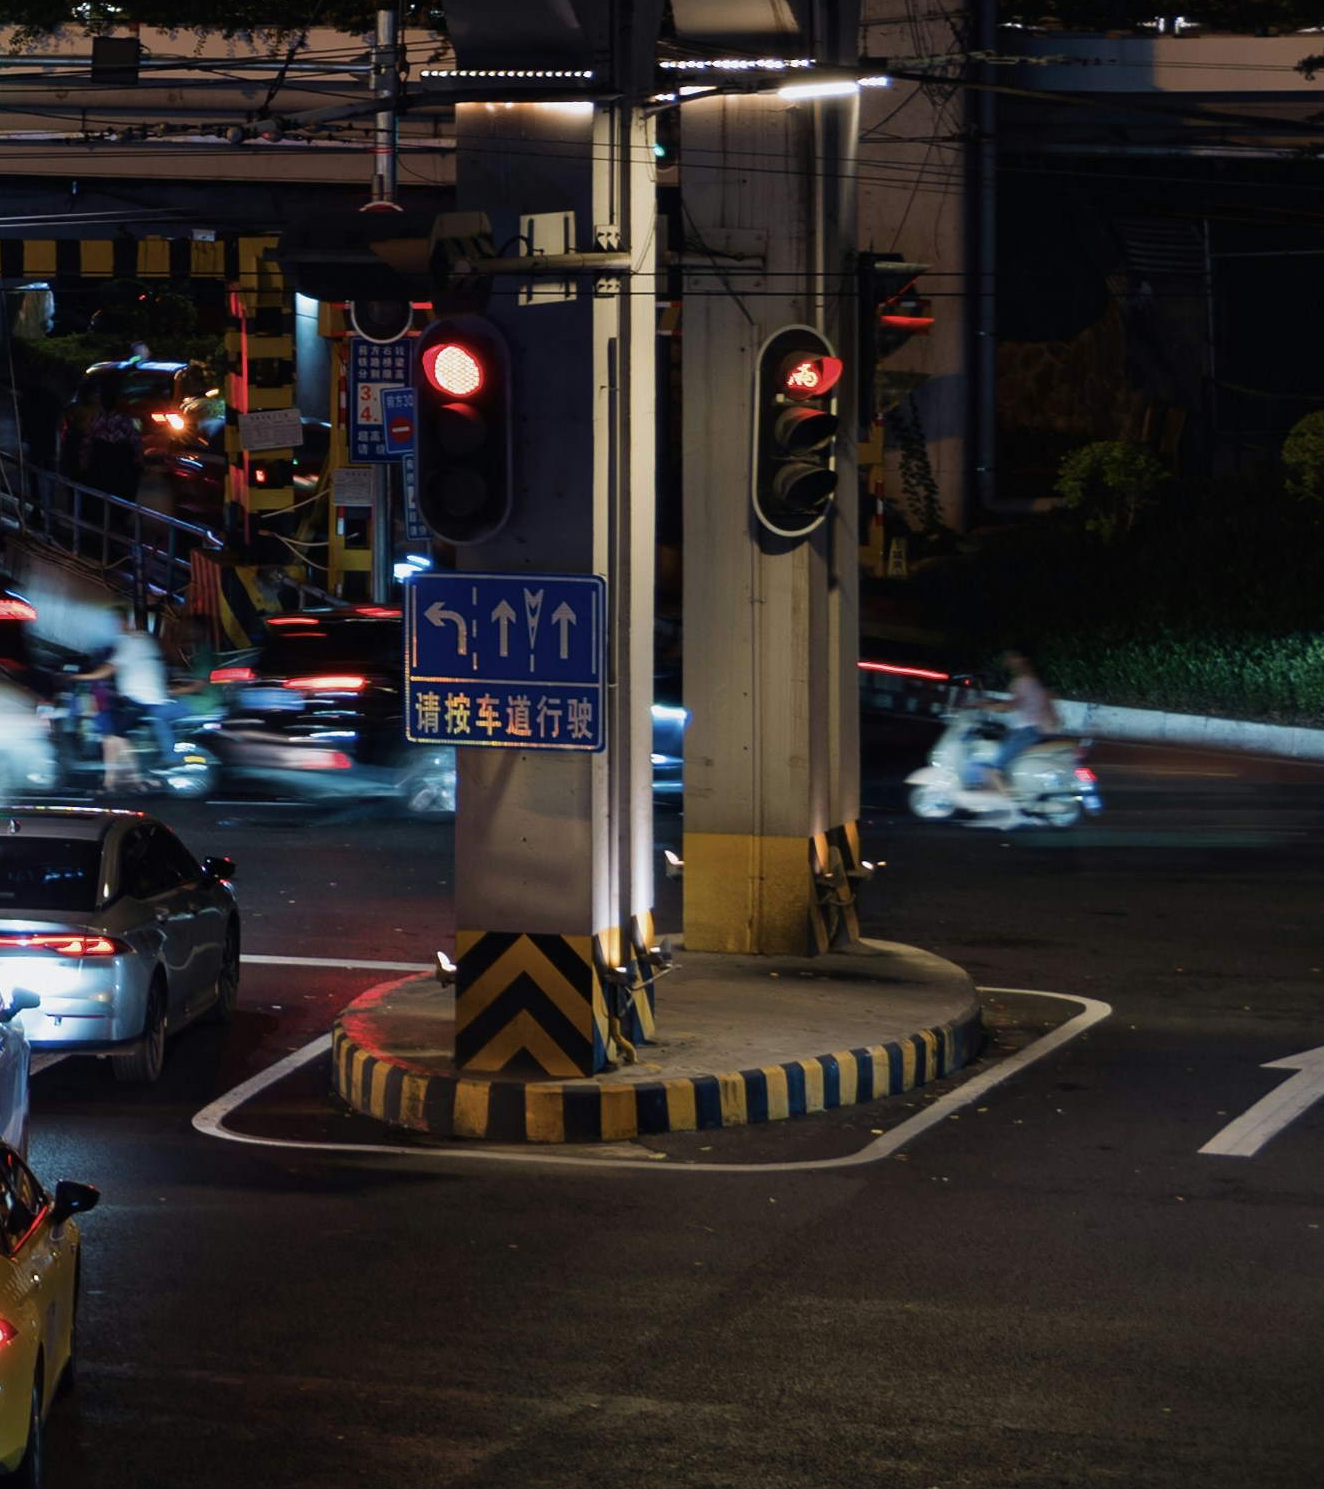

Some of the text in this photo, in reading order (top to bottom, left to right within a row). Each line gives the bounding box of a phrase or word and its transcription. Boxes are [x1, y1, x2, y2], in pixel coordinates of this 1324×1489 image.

[415, 690, 594, 739] 请按车道行驶
